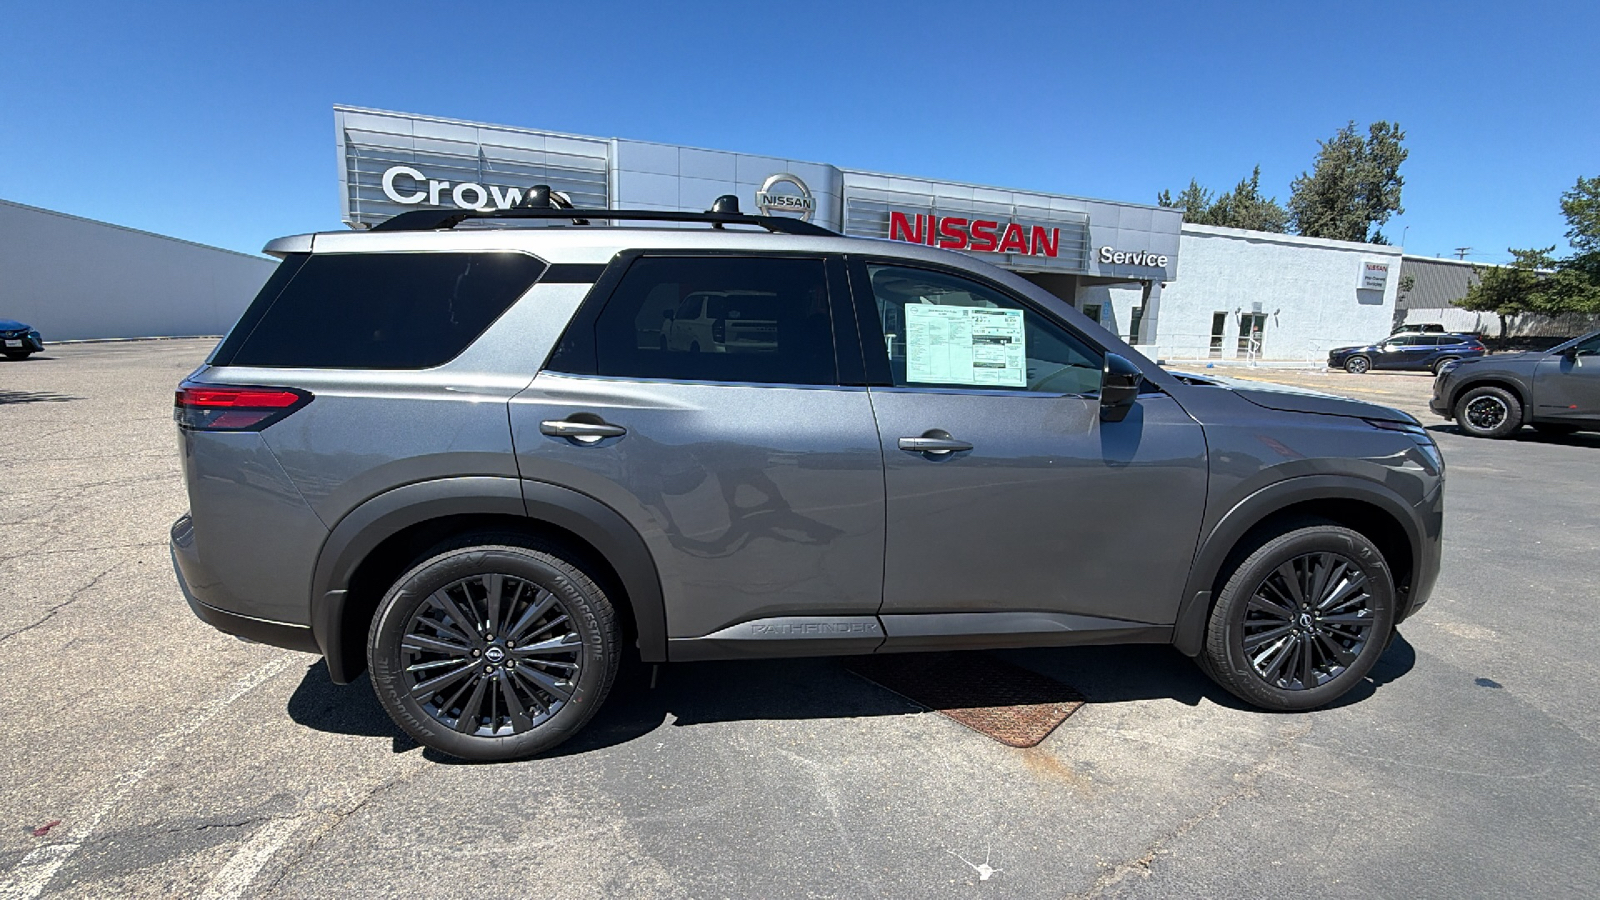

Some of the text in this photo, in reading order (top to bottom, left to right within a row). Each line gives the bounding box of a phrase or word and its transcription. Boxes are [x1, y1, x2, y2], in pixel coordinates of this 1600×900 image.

[382, 166, 572, 210] Crow
[763, 195, 811, 209] NISSAN
[889, 211, 1060, 258] NISSAN
[1100, 246, 1168, 268] Service
[553, 576, 604, 661] BRIDGESTONE
[751, 622, 878, 635] PATHFINDER
